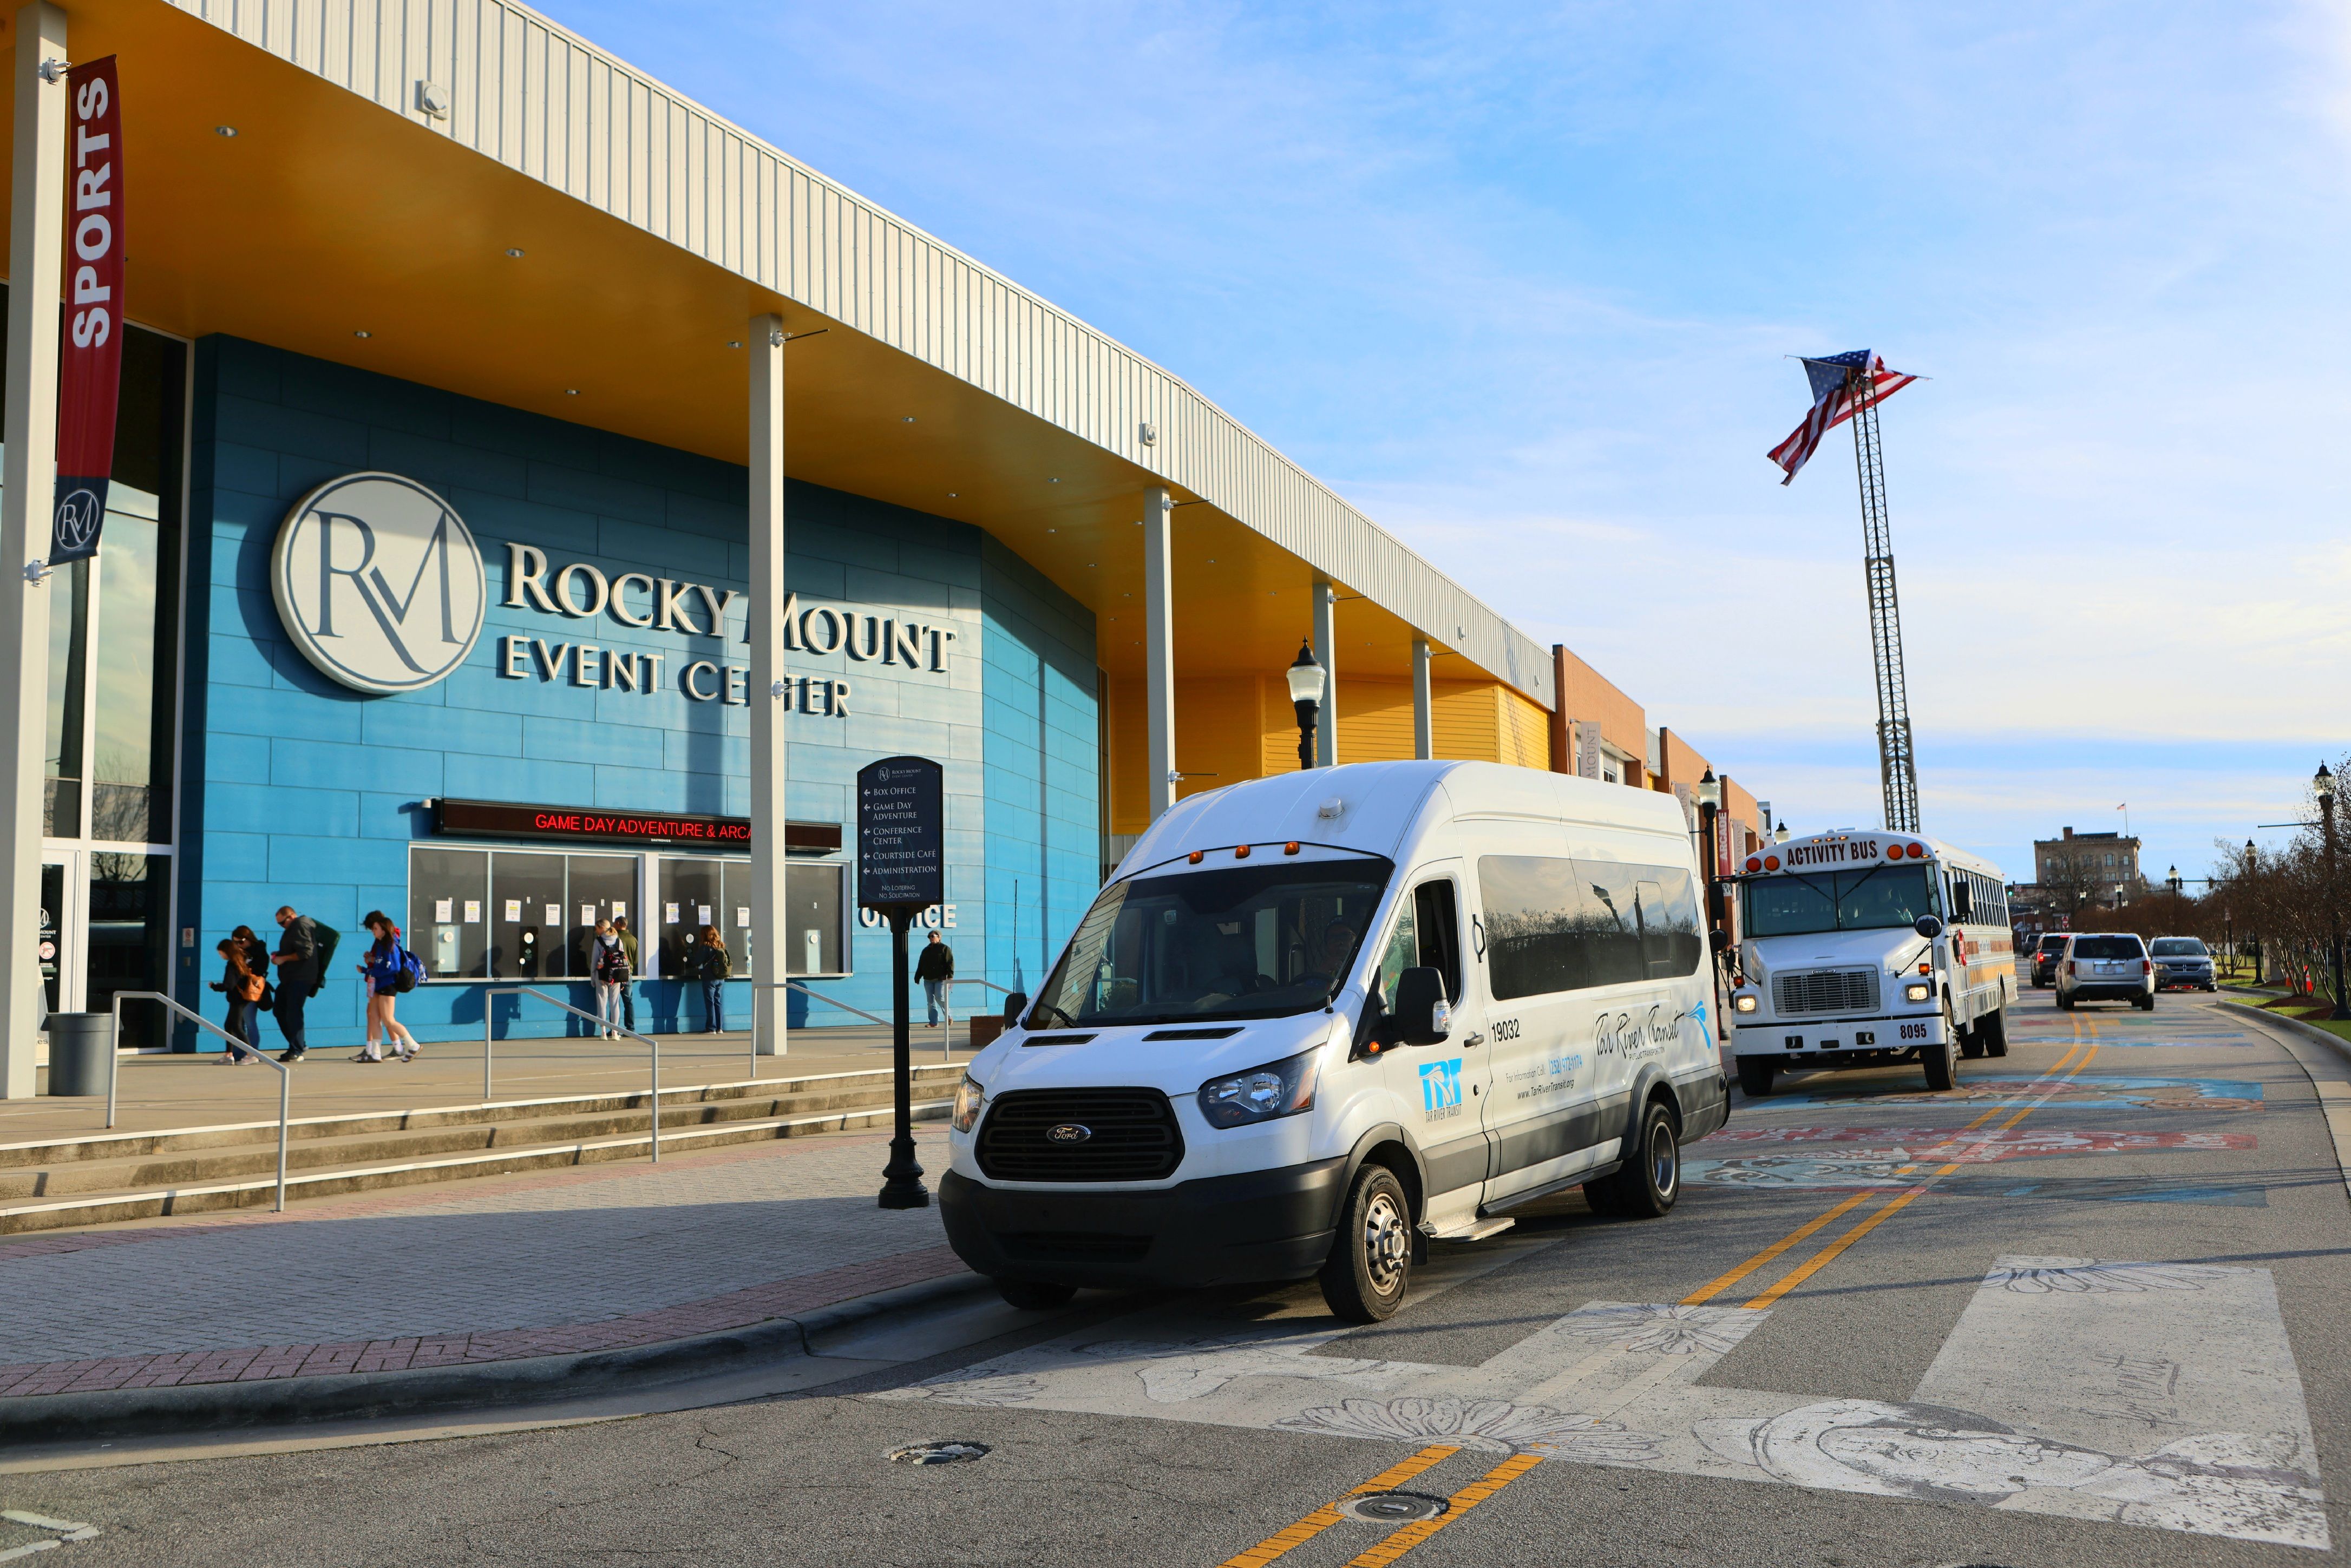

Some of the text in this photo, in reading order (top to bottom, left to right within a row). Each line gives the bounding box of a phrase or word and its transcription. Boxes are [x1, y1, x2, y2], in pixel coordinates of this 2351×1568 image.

[73, 77, 112, 348] SPORTS
[505, 542, 739, 638] ROCKY
[506, 634, 852, 717] EVENT CETER
[890, 787, 916, 795] OFFICE
[873, 802, 912, 811] GAME DAY
[873, 811, 918, 821] ADVENTURE
[535, 814, 580, 830] GAME
[585, 817, 615, 832] DAY
[617, 819, 703, 837] ADVENTURE
[706, 824, 716, 838] &
[873, 826, 922, 835] CONFERENCE
[873, 837, 902, 845] CENTER
[1718, 812, 1728, 861] ARCADE
[873, 849, 936, 860] COURTSIDE CAFÉ
[1787, 840, 1878, 866] ACTIVITY BUS
[872, 865, 937, 875] ADMINISTRATION
[862, 904, 957, 927] OICE
[1491, 1018, 1520, 1042] 19032
[1596, 1005, 1685, 1059] Tar River Transit
[1900, 1023, 1927, 1039] 8095
[1514, 1068, 1537, 1081] Information
[1537, 1064, 1546, 1076] Call:
[1548, 1056, 1562, 1077] (252)
[1517, 1079, 1574, 1100] www.TarRiverTransit.org
[1433, 1107, 1445, 1121] RIVER
[1446, 1104, 1462, 1118] TRANSIT
[1055, 1127, 1079, 1140] Ford
[1371, 1177, 1393, 1191] Dynapro
